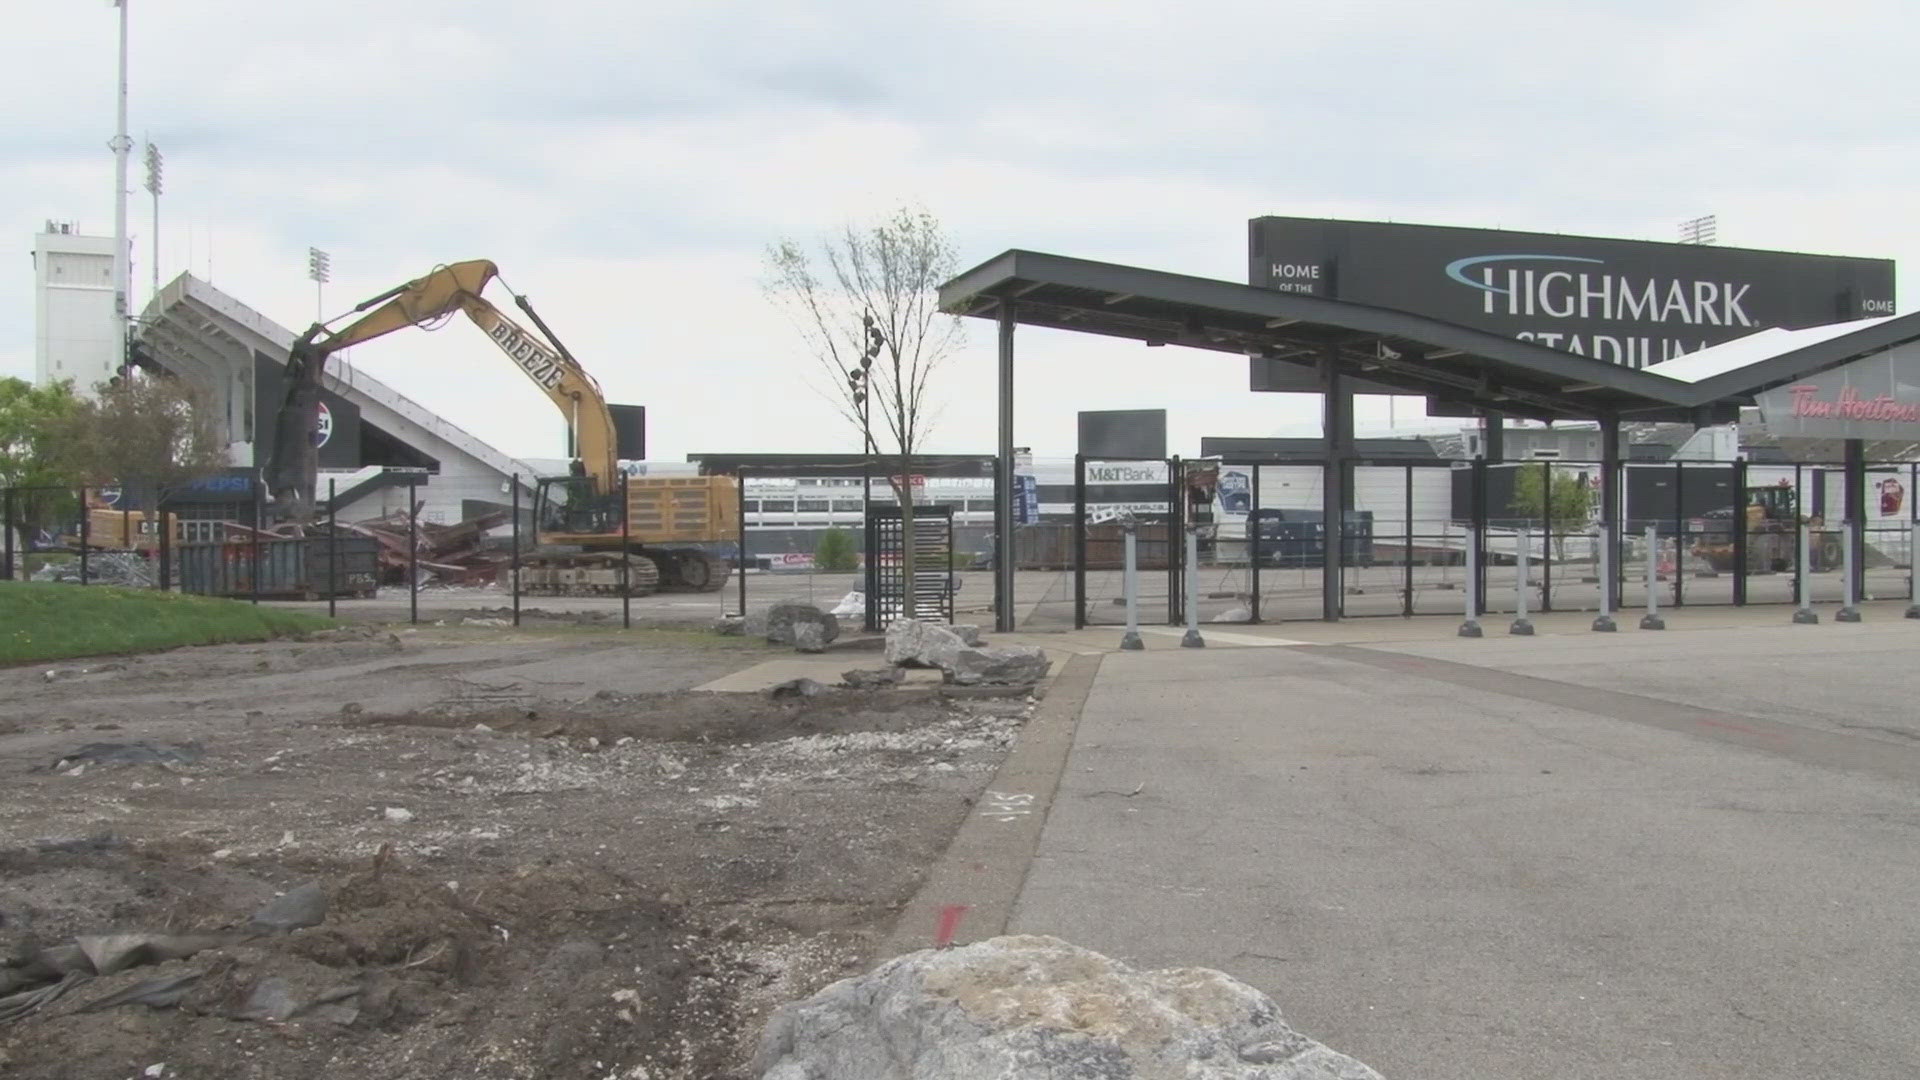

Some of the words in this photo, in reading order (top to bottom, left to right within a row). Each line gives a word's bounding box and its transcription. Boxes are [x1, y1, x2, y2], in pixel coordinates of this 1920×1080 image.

[1272, 264, 1319, 279] HOME
[1279, 283, 1293, 292] OF
[1295, 283, 1313, 293] THE
[1484, 267, 1751, 327] HIGHMARK
[491, 323, 566, 390] BREEZE
[1515, 331, 1707, 369] ADIU
[1789, 384, 1832, 419] Tim
[141, 522, 160, 534] CT
